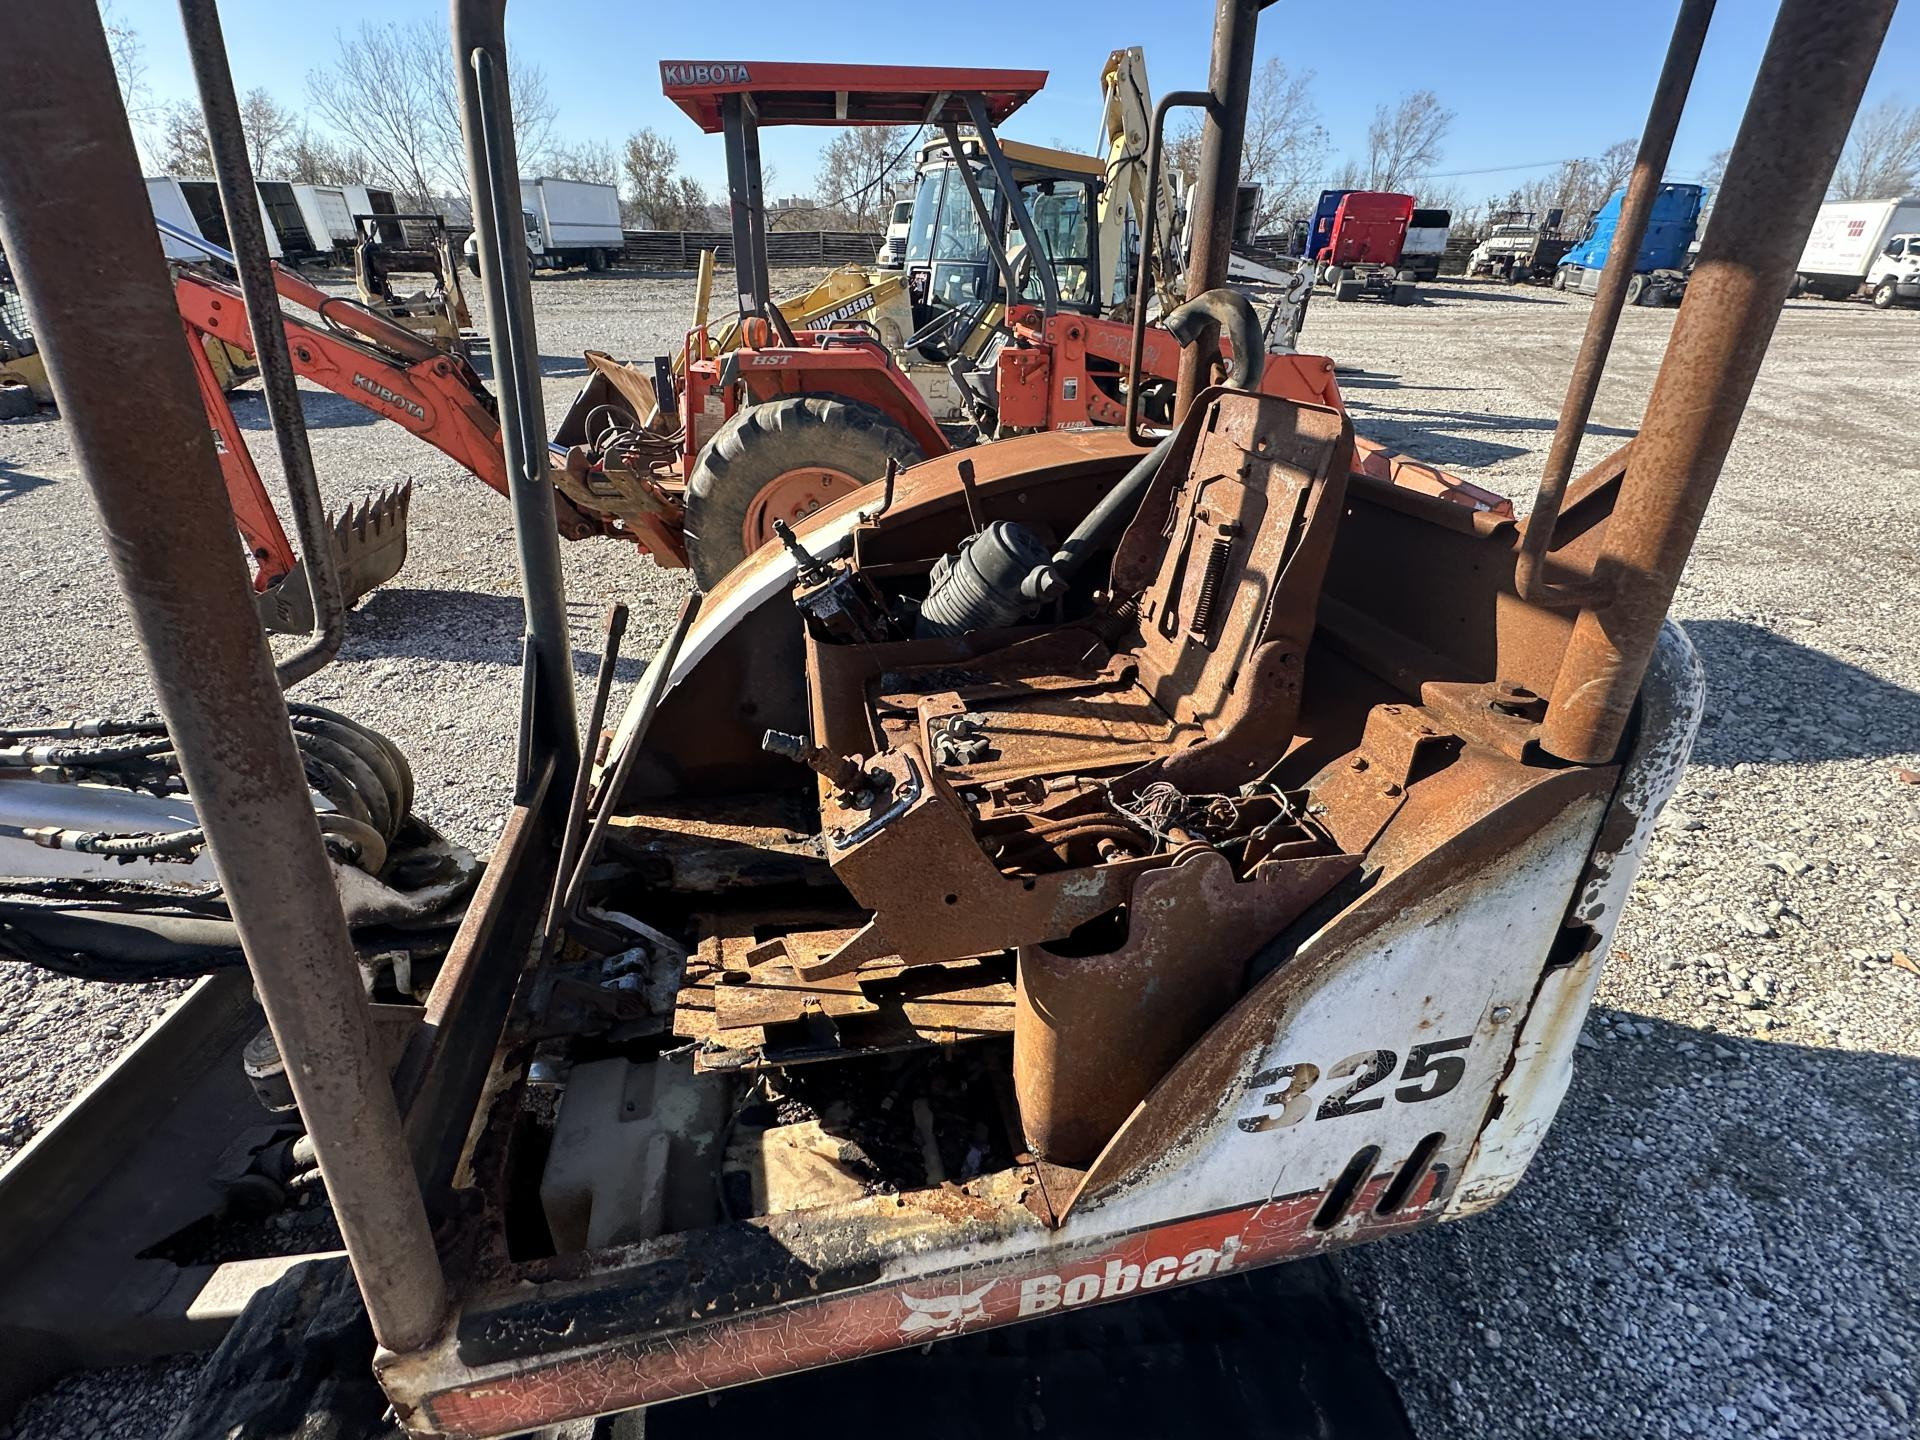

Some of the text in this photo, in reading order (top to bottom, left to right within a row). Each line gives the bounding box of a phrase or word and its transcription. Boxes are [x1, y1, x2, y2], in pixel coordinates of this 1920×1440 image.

[663, 63, 751, 84] KUBOTA
[807, 293, 875, 331] JOHN DEERE
[752, 355, 792, 366] HST
[353, 372, 425, 421] KUBOTA
[1238, 1035, 1473, 1133] 325
[1018, 1235, 1246, 1318] Bobcat
